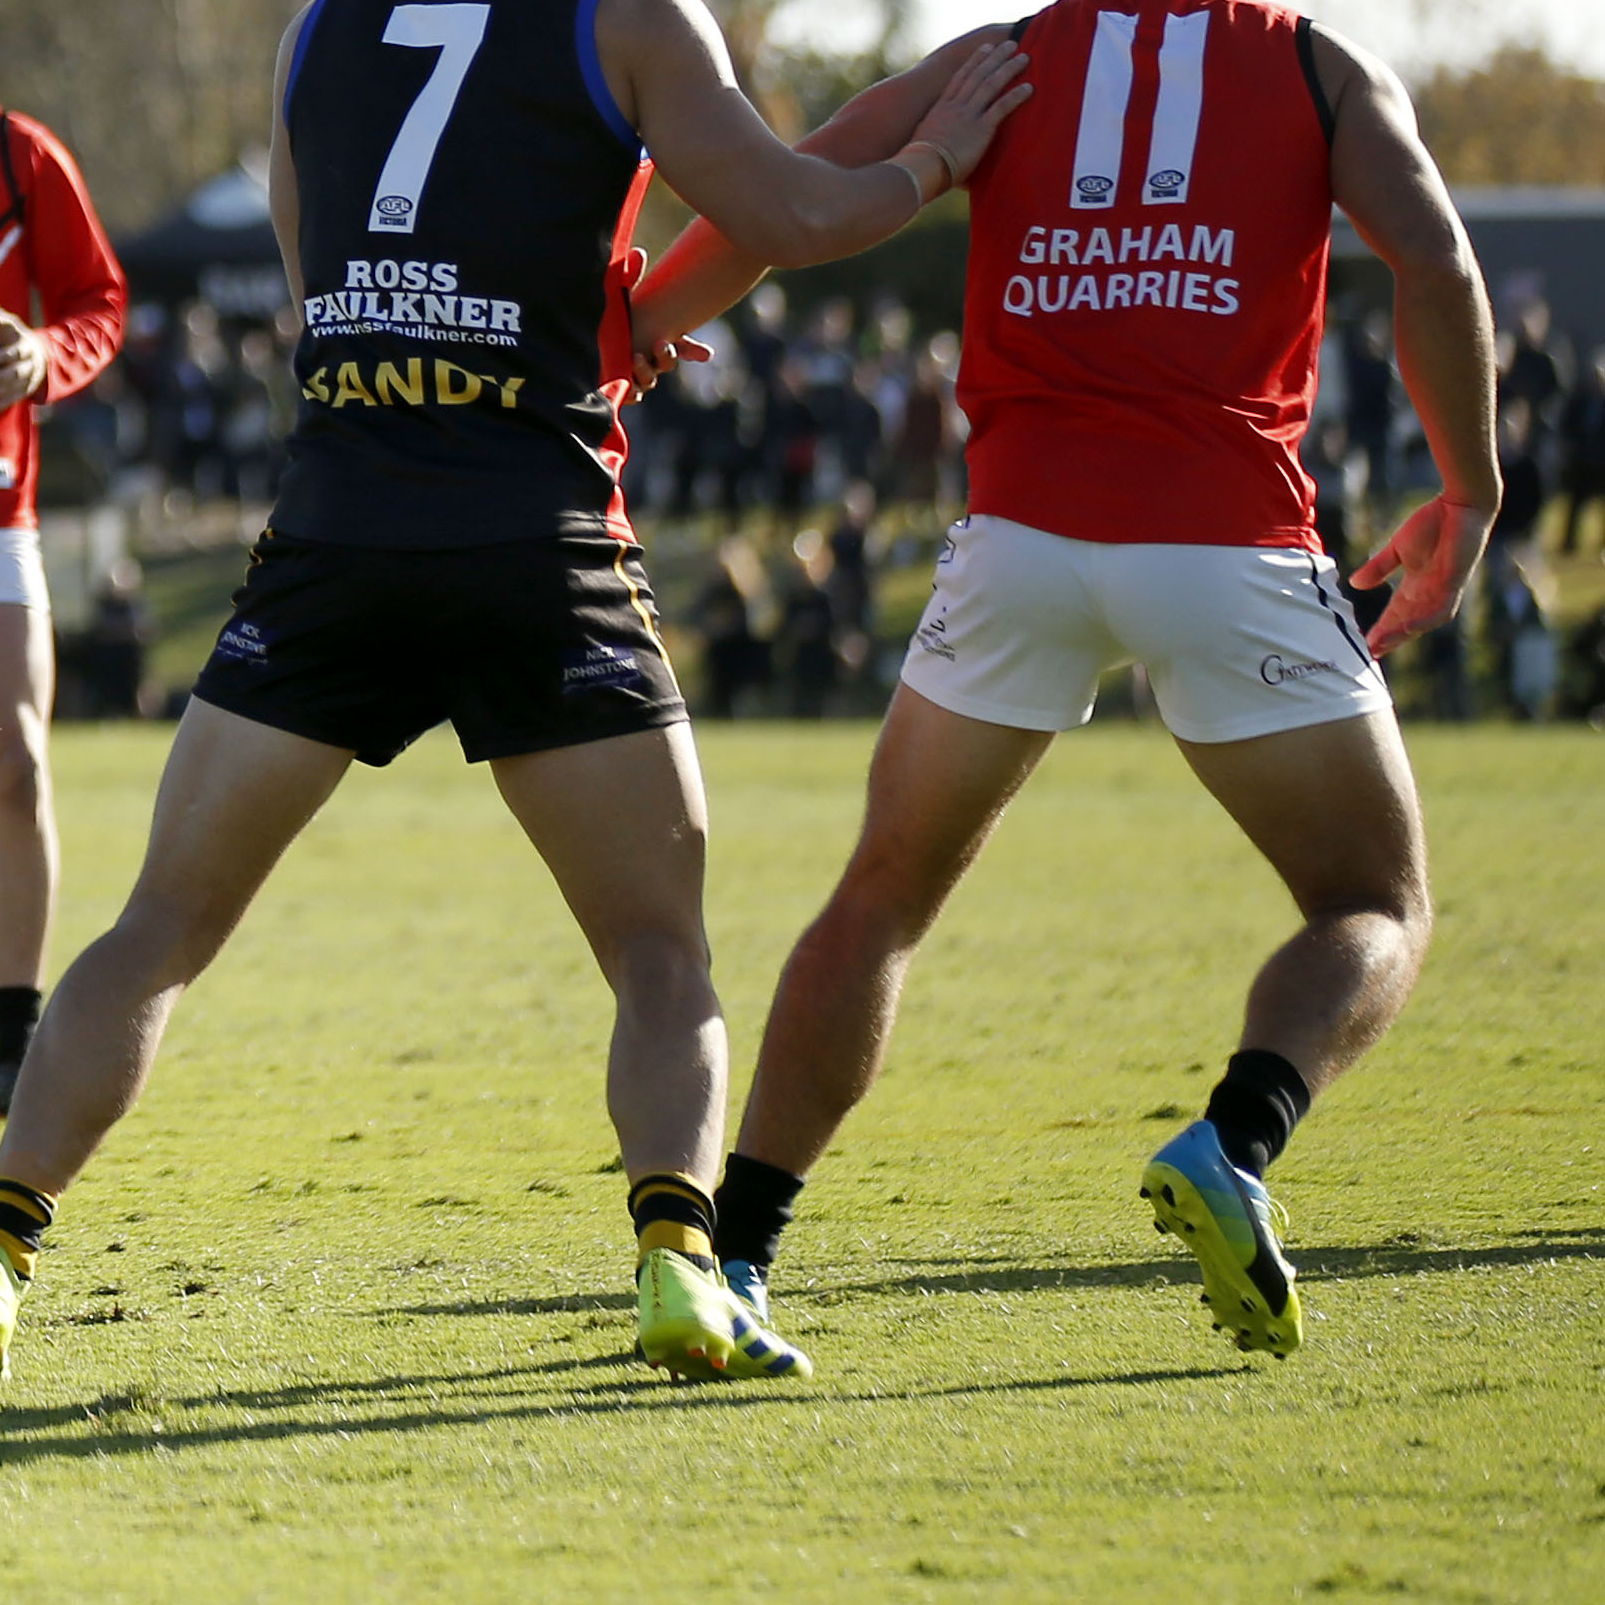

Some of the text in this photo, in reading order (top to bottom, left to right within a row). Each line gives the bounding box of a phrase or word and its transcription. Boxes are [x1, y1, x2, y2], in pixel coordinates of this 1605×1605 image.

[368, 2, 491, 233] 7
[1070, 10, 1210, 209] 11
[1019, 223, 1234, 267] GRAHAM
[345, 259, 458, 292] ROSS
[1003, 270, 1240, 318] QUARRIES
[304, 291, 522, 333] FAULKNER
[302, 357, 525, 409] SANDY
[564, 657, 638, 681] JOHNSTONE
